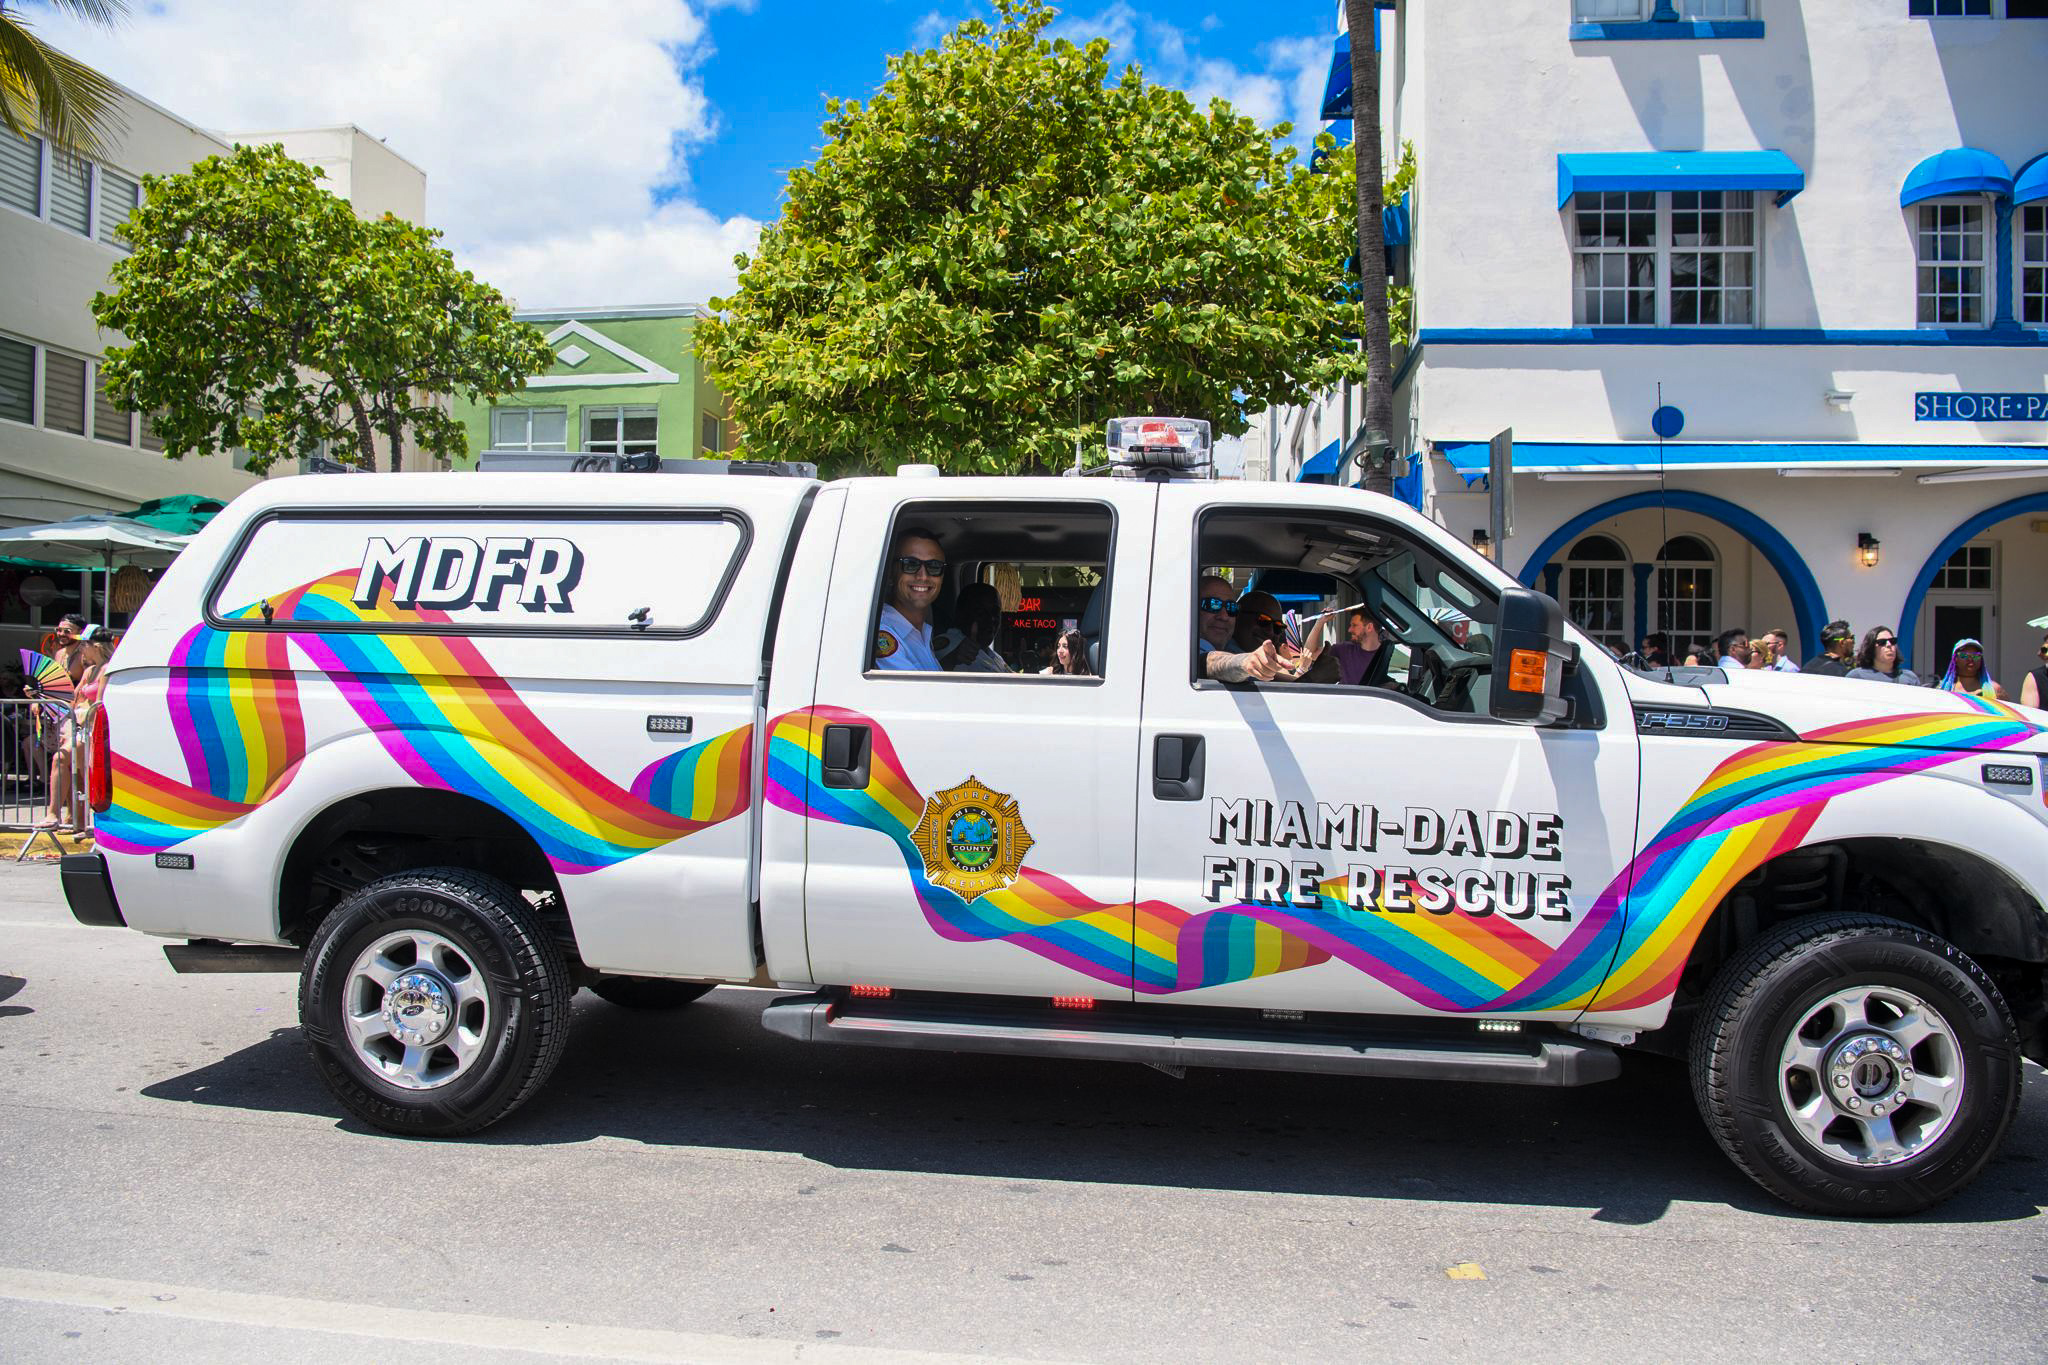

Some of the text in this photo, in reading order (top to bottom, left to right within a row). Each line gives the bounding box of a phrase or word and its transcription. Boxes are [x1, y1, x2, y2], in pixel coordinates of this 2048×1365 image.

[1917, 395, 2012, 418] SHORE
[350, 537, 584, 613] MDFR
[1018, 597, 1041, 612] BAR
[1013, 619, 1031, 628] AKE
[1033, 619, 1056, 628] TACO
[952, 791, 990, 801] FIRE
[1209, 796, 1563, 861] MIAMI-DADE
[951, 856, 994, 872] FLORIDA
[1202, 855, 1572, 922] FIRE RESCUE
